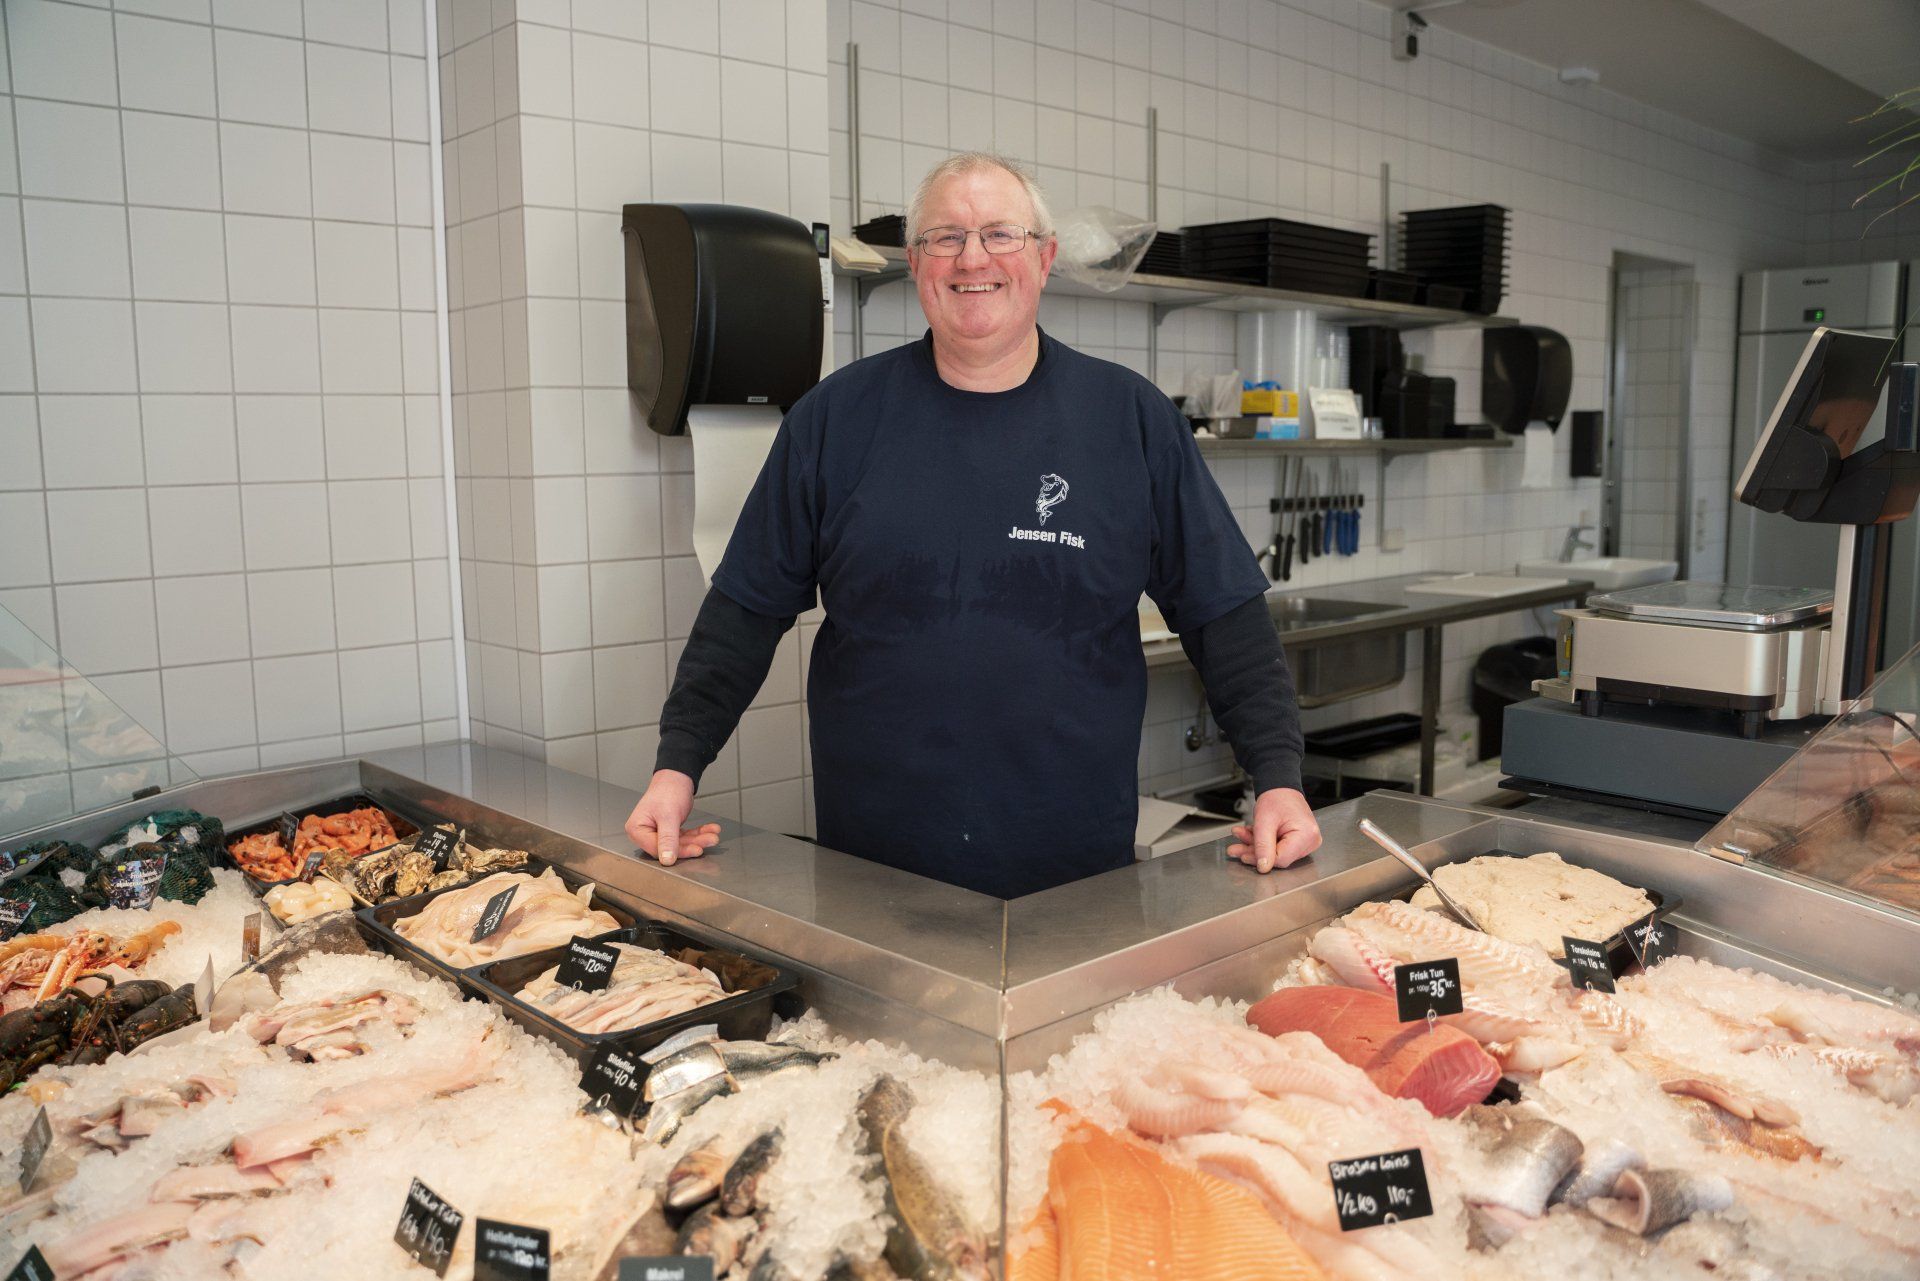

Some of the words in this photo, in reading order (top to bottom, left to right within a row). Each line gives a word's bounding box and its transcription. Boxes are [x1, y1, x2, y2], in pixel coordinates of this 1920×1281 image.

[1008, 526, 1056, 542] Jensen
[1060, 531, 1085, 549] Fisk
[571, 942, 613, 962] Rødspættefilet
[585, 958, 601, 973] 120
[1409, 971, 1429, 981] Frisk
[1429, 968, 1444, 979] Tun
[1445, 980, 1455, 989] kr.
[607, 1053, 636, 1074] Sildefilet
[614, 1069, 629, 1087] 40
[628, 1079, 638, 1091] kr.
